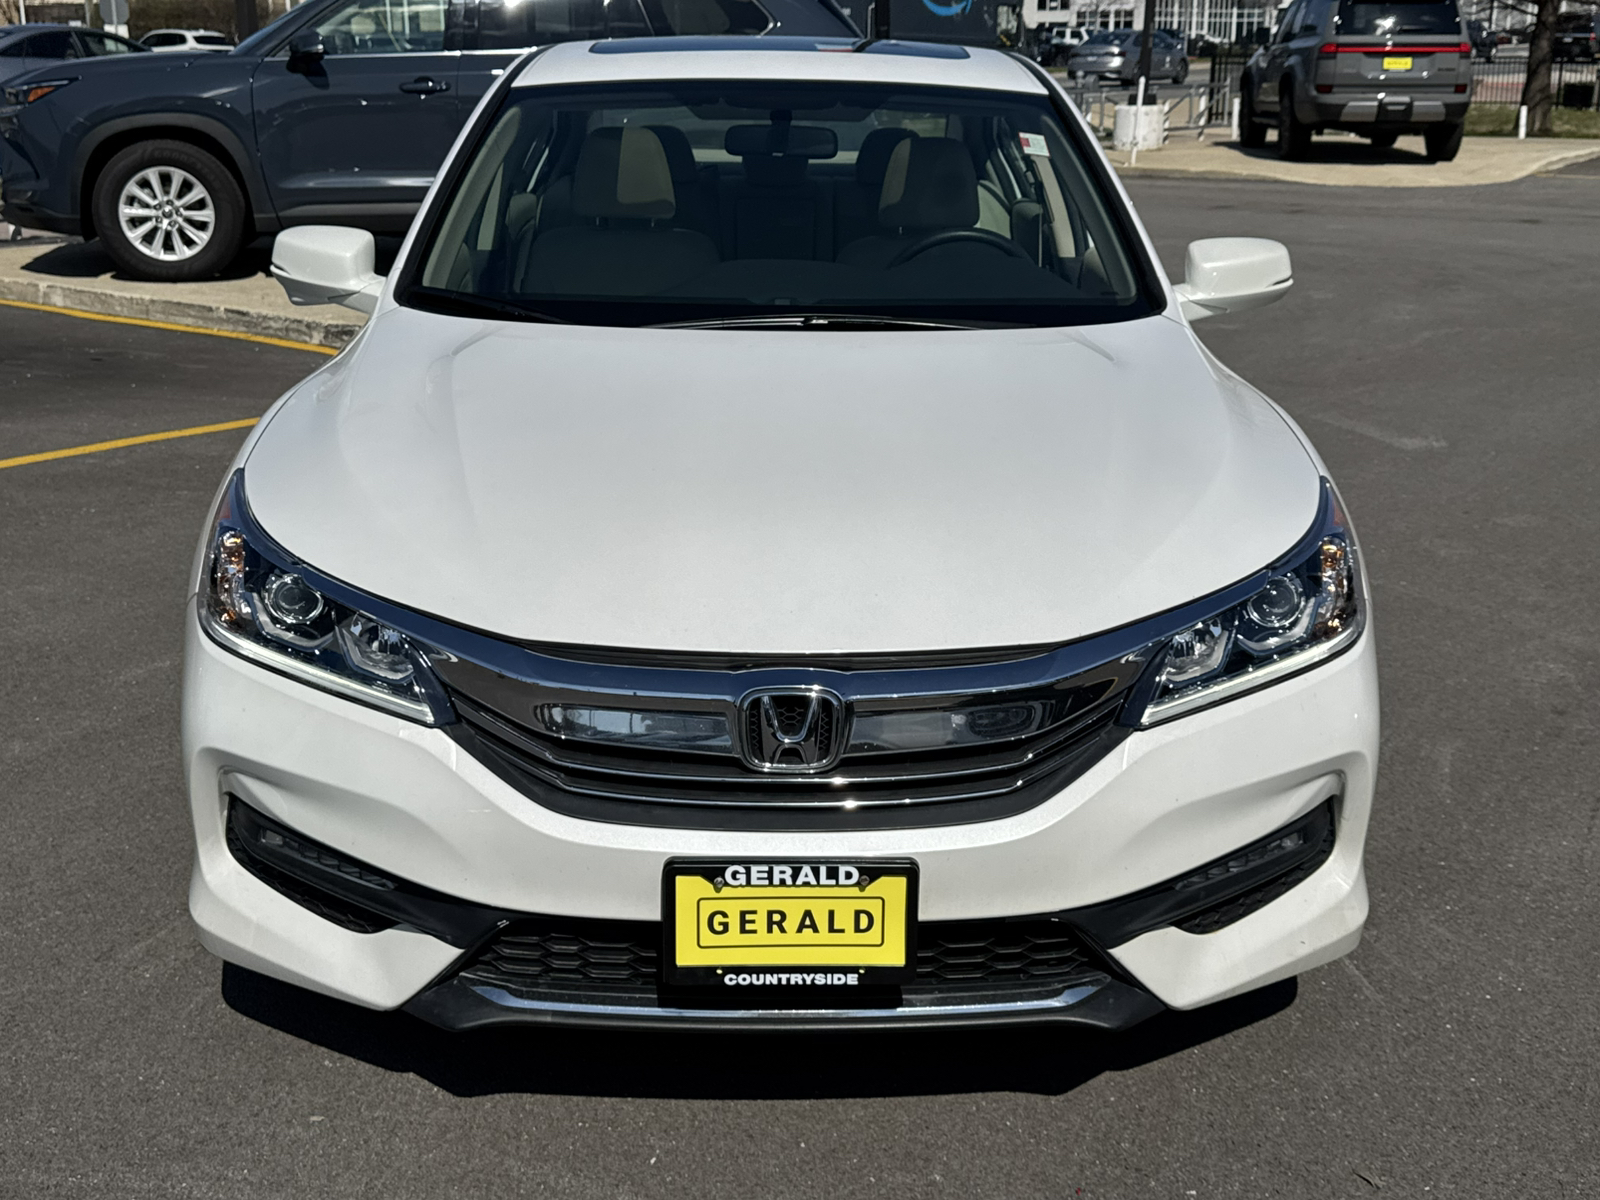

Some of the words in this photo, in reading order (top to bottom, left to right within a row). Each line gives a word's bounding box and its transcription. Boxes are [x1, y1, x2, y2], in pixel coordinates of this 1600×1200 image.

[724, 865, 860, 886] GERALD
[706, 909, 875, 935] GERALD
[723, 973, 859, 986] COUNTRYSIDE
